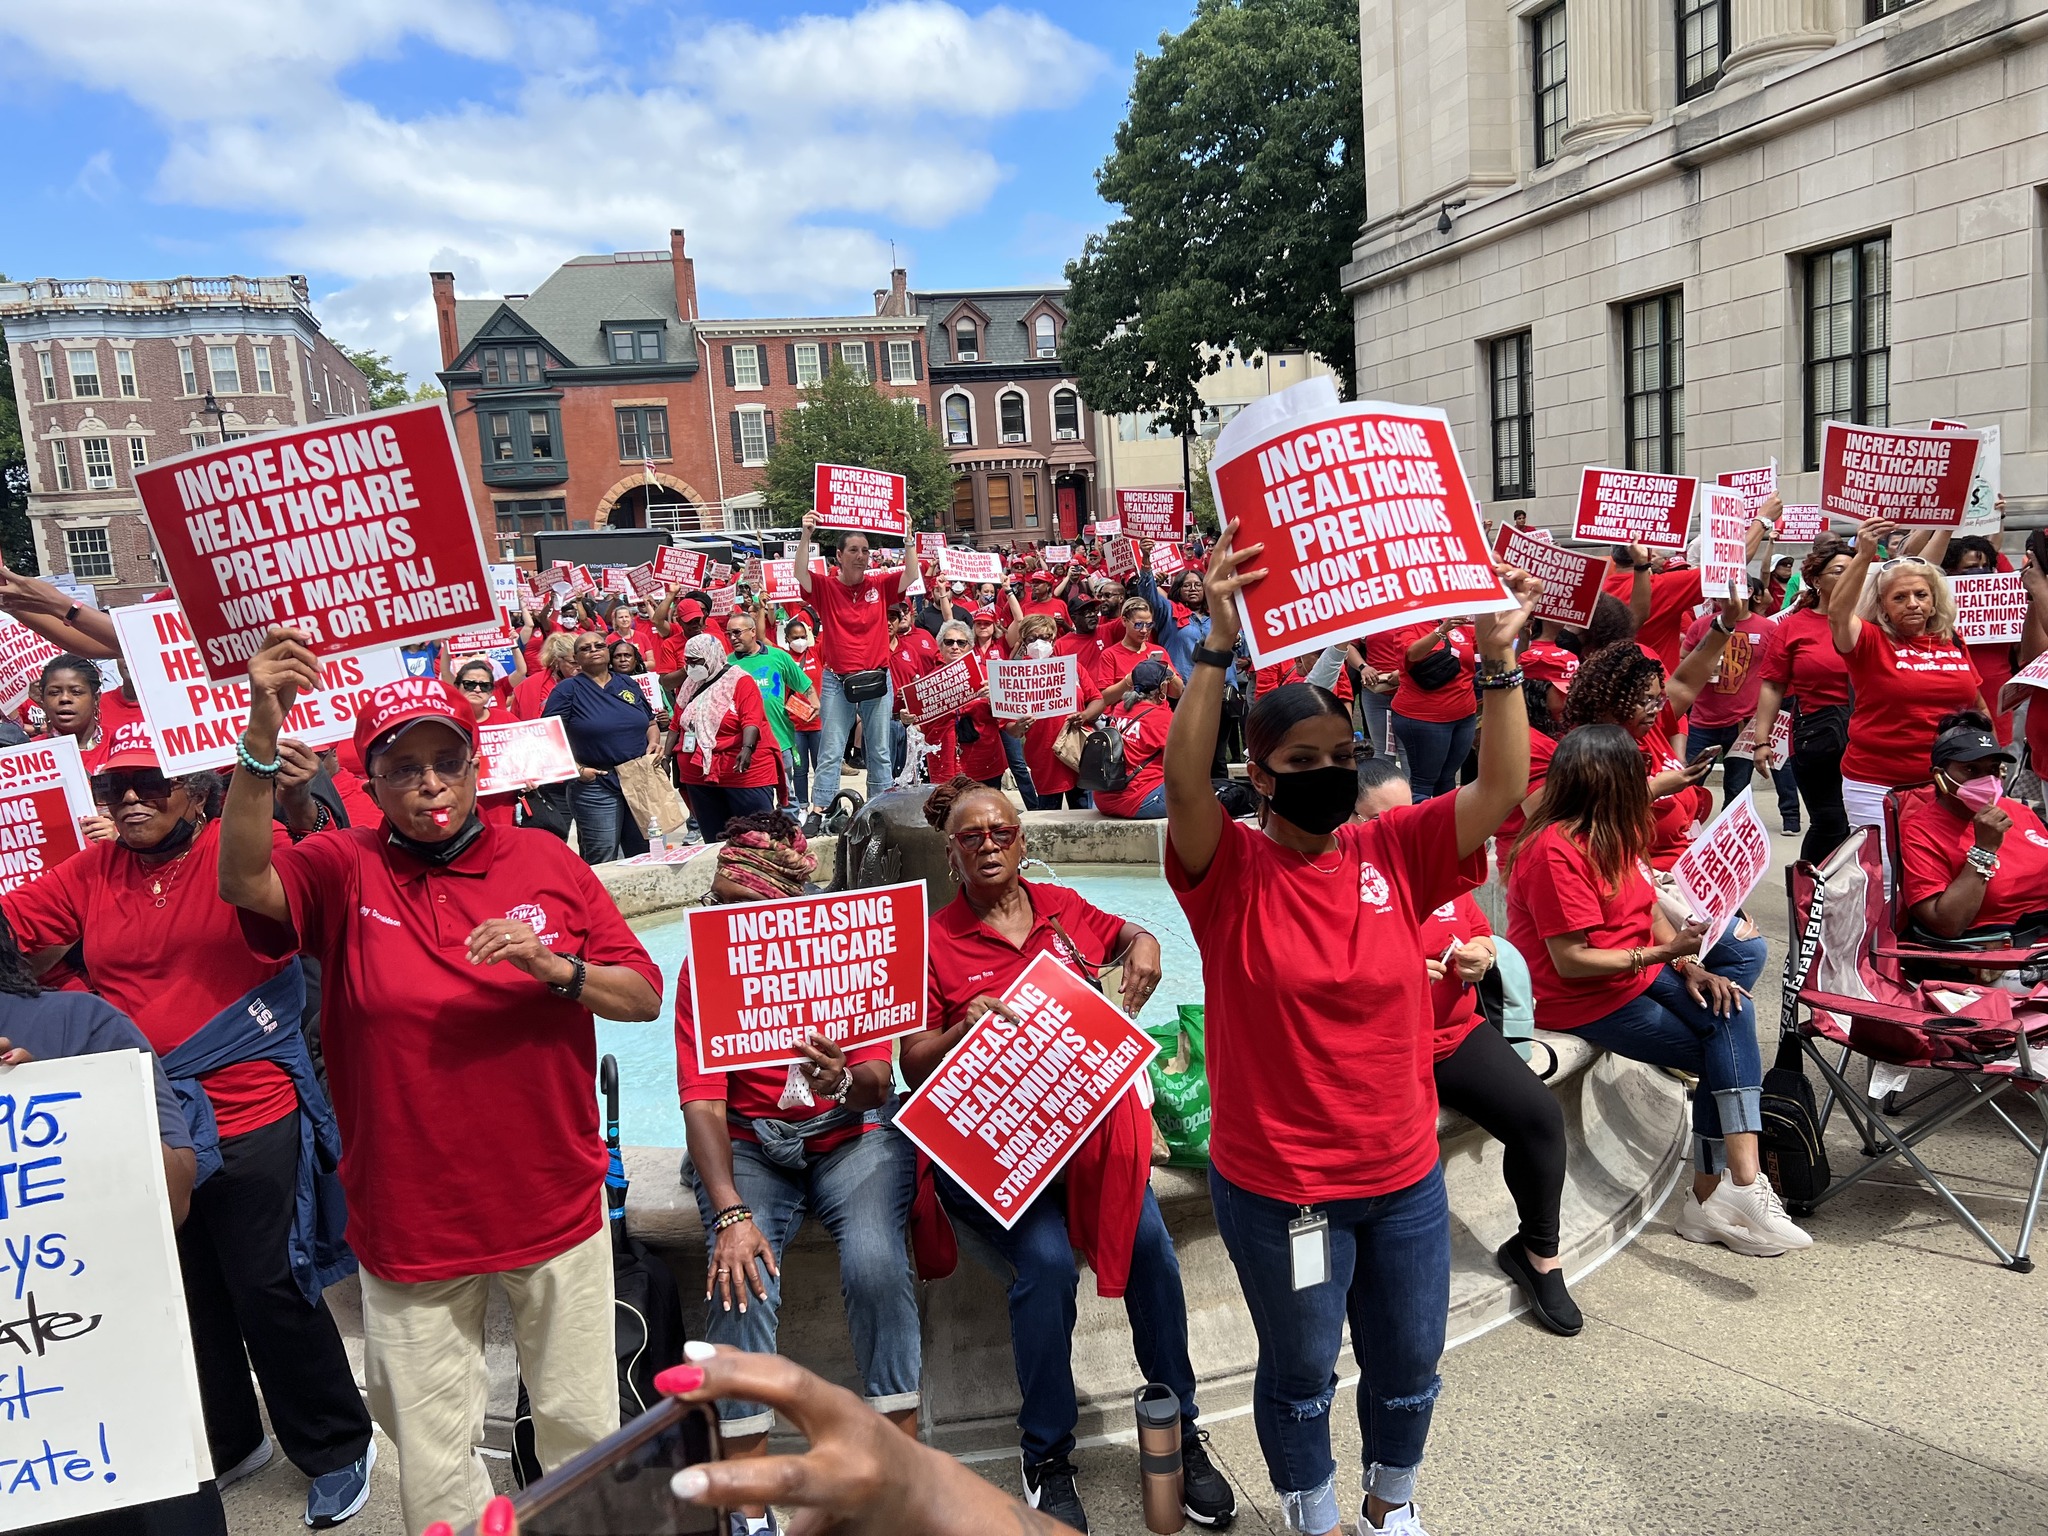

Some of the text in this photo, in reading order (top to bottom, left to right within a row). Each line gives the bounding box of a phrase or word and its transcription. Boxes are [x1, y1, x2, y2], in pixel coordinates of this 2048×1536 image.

[1257, 419, 1433, 488] INCREASING
[1846, 432, 1952, 459] INCREASING
[174, 424, 404, 511] INCREASING
[1842, 451, 1950, 477] HEALTHCARE
[830, 468, 893, 487] INCREASING
[1599, 473, 1679, 493] INCREASING
[1845, 470, 1938, 495] PREMIUMS
[829, 480, 894, 500] HEALTHCARE
[1123, 492, 1174, 503] INCREASING
[1263, 458, 1448, 529] HEALTHCARE
[1595, 488, 1678, 508] HEALTHCARE
[1841, 485, 1940, 507] WON'T MAKE NJ
[185, 468, 421, 556] HEALTHCARE
[830, 505, 893, 520] WON'T MAKE NJ
[833, 493, 890, 511] PREMIUMS
[1124, 503, 1174, 514] HEALTHCARE
[1598, 502, 1670, 521] PREMIUMS
[1826, 494, 1955, 521] STRONGER OR FAIRER!
[820, 513, 903, 531] STRONGER OR FAIRER!
[1127, 512, 1171, 523] PREMIUMS
[1143, 523, 1162, 531] MAKE
[1594, 515, 1671, 533] WON'T MAKE NJ
[1785, 521, 1821, 529] PREMIUMS
[1146, 531, 1155, 539] OR
[1156, 531, 1181, 539] FAIRER!
[1289, 498, 1452, 563] PREMIUMS
[1579, 525, 1682, 544] STRONGER OR FAIRER!
[211, 516, 417, 597] PREMIUMS
[663, 555, 699, 568] HEALTHCARE
[664, 548, 700, 560] INCREASING
[945, 550, 992, 560] INCREASING
[946, 556, 993, 566] HEALTHCARE
[1508, 533, 1587, 573] INCREASING
[663, 563, 695, 574] PREMIUMS
[950, 563, 992, 573] PREMIUMS
[1290, 536, 1467, 596] WON'T MAKE NJ
[1503, 547, 1585, 587] HEALTHCARE
[219, 586, 295, 630] WON'T
[302, 565, 392, 611] MAKE
[394, 556, 436, 592] NJ
[1955, 577, 2022, 593] INCREASIN
[328, 604, 371, 640] OR
[375, 580, 481, 627] FAIRER!
[1263, 563, 1496, 638] STRONGER OR FAIRER!
[1558, 598, 1575, 609] NJ
[1544, 605, 1586, 621] FAIRER!
[1959, 607, 2027, 624] PREMIUMS
[477, 633, 494, 641] MAKE
[1989, 623, 2007, 636] ME
[914, 660, 968, 693] INCREASING
[998, 661, 1066, 678] INCREASING
[916, 669, 971, 701] HEALTHCARE
[998, 673, 1066, 690] HEALTHCARE
[374, 680, 448, 707] CWA
[921, 681, 971, 707] PREMIUMS
[921, 687, 975, 715] WON'T MAKE NJ
[1004, 687, 1062, 703] PREMIUMS
[914, 699, 959, 724] STRONGER OR
[994, 697, 1073, 715] MAKES ME SICK!
[115, 721, 152, 741] CW
[161, 714, 250, 757] MAKE
[281, 699, 325, 734] ME
[480, 725, 547, 744] INCREASING
[1679, 850, 1712, 902] MAKES
[727, 895, 894, 943] INCREASING
[727, 925, 897, 976] HEALTHCARE
[742, 958, 888, 1006] PREMIUMS
[737, 985, 895, 1031] WON'T MAKE NJ
[824, 1020, 849, 1042] OR
[853, 1001, 917, 1037] FAIRER!
[926, 982, 1048, 1115] INCREASING
[946, 996, 1073, 1138] HEALTHCARE
[976, 1026, 1087, 1151] PREMIUMS
[993, 1039, 1110, 1171] WON'T MAKE NJ
[993, 1034, 1144, 1208] STRONGER OR FAIRER!
